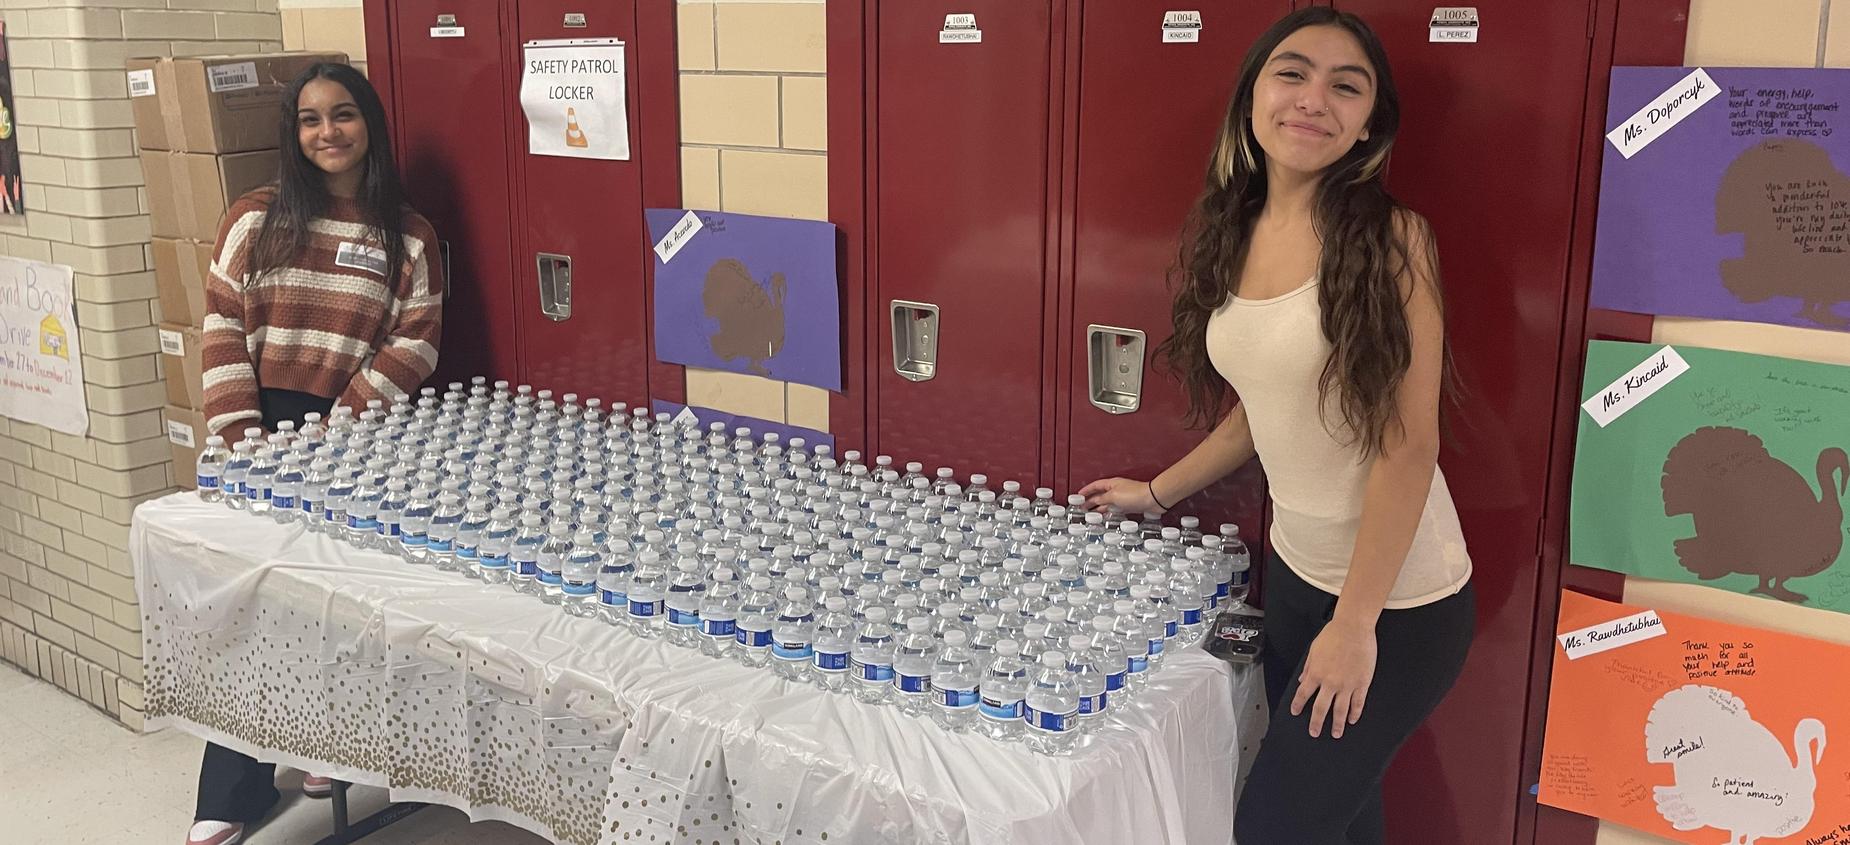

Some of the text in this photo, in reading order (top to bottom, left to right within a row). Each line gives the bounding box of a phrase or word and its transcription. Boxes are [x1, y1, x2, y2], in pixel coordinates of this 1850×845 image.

[953, 16, 969, 24] 1003
[1173, 13, 1193, 22] 1004
[1444, 10, 1468, 20] 1005
[1169, 31, 1192, 39] KINCAID
[530, 60, 618, 74] SAFETY PATROL
[549, 86, 594, 100] LOCKER
[1760, 99, 1771, 107] of
[1624, 77, 1705, 146] Ms. Doporcyk
[1603, 355, 1669, 412] Ms. Kincaid
[1565, 636, 1586, 652] Ms.
[1682, 640, 1709, 651] Thank
[1720, 642, 1734, 651] you
[1719, 651, 1730, 659] for
[1682, 657, 1754, 672] your help and
[1688, 668, 1756, 680] positive attitude
[1724, 778, 1754, 789] patient
[1722, 787, 1742, 796] and
